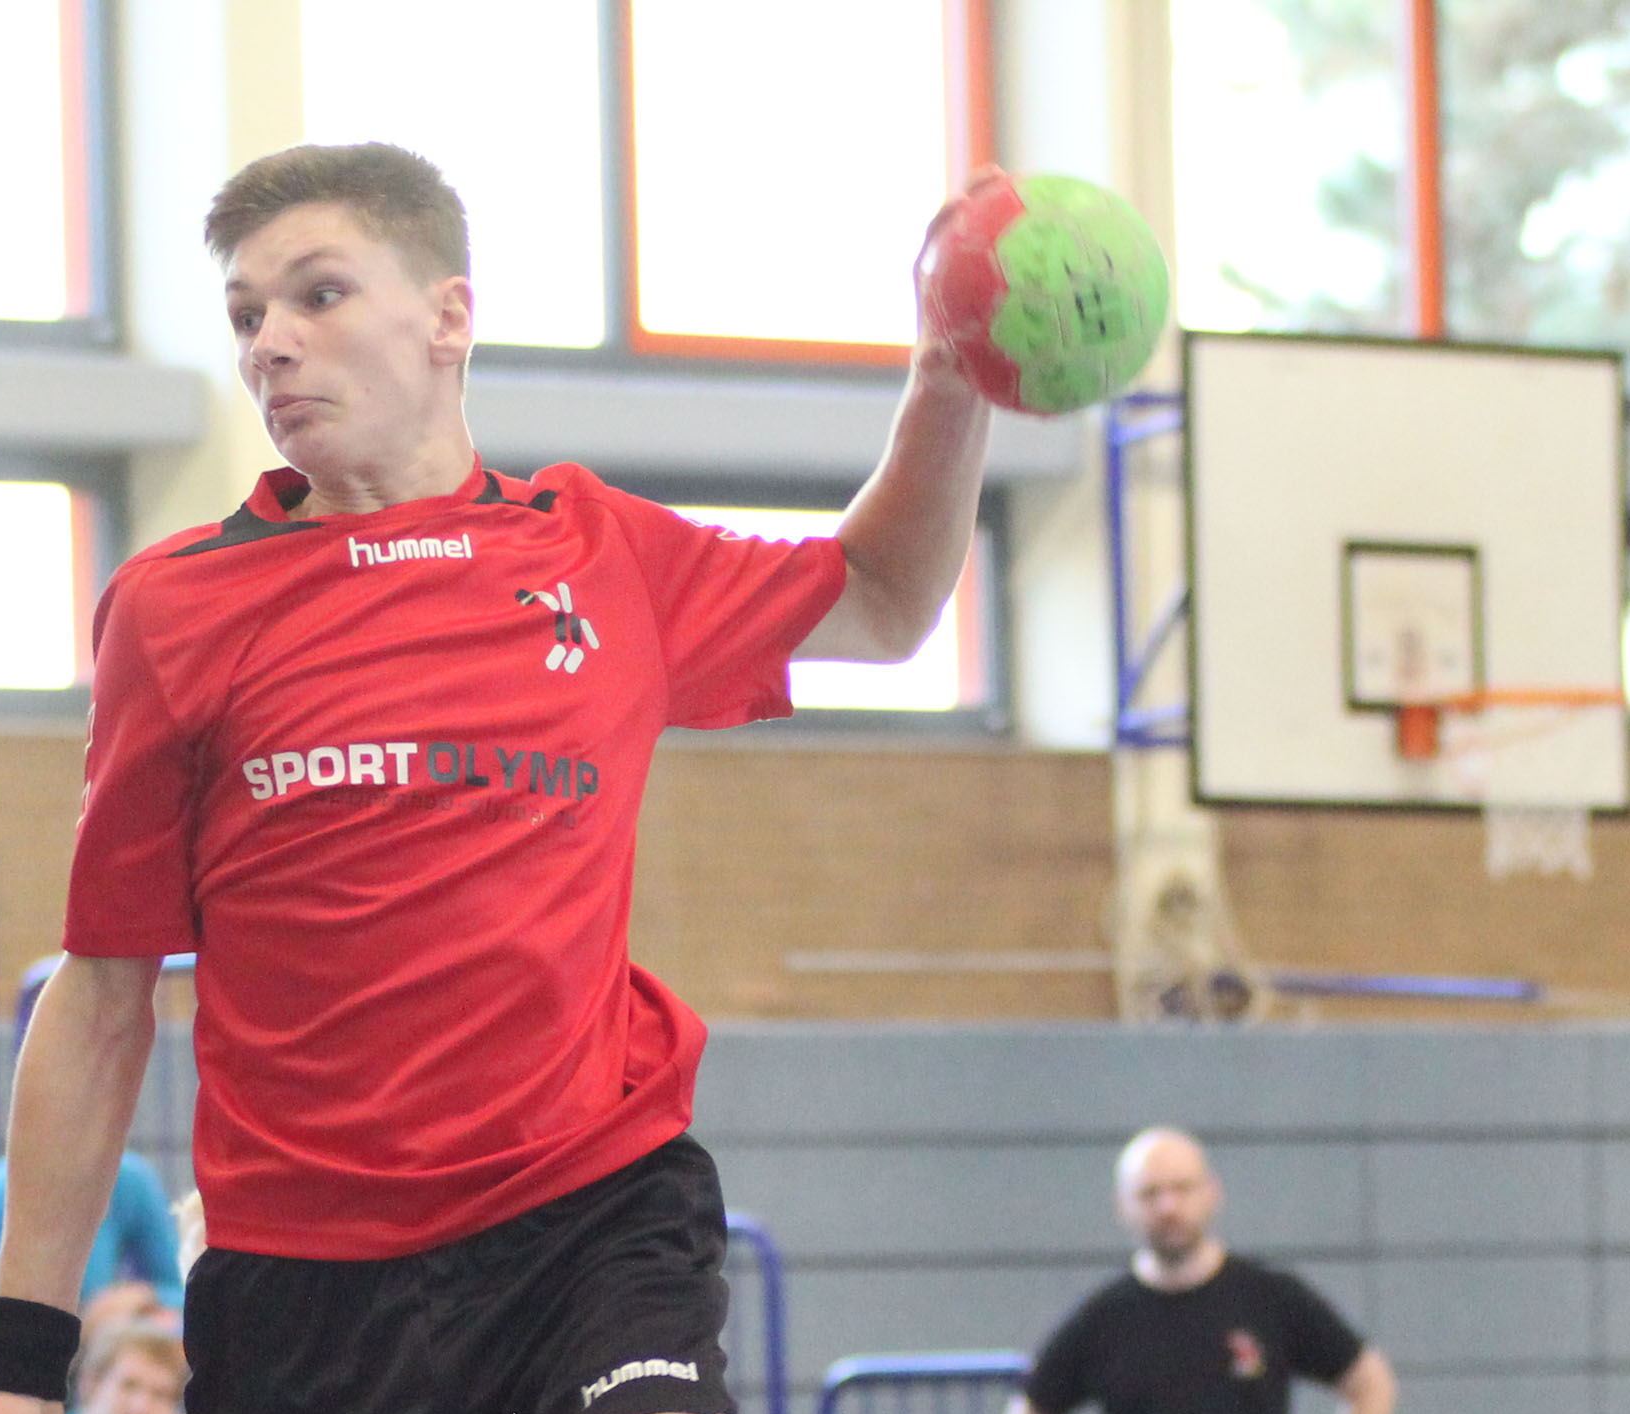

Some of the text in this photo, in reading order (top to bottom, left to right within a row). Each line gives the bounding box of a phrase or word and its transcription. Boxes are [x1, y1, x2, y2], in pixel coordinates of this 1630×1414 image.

[348, 533, 473, 568] hummel
[242, 742, 418, 800] SPORT
[580, 1358, 700, 1409] hummel
